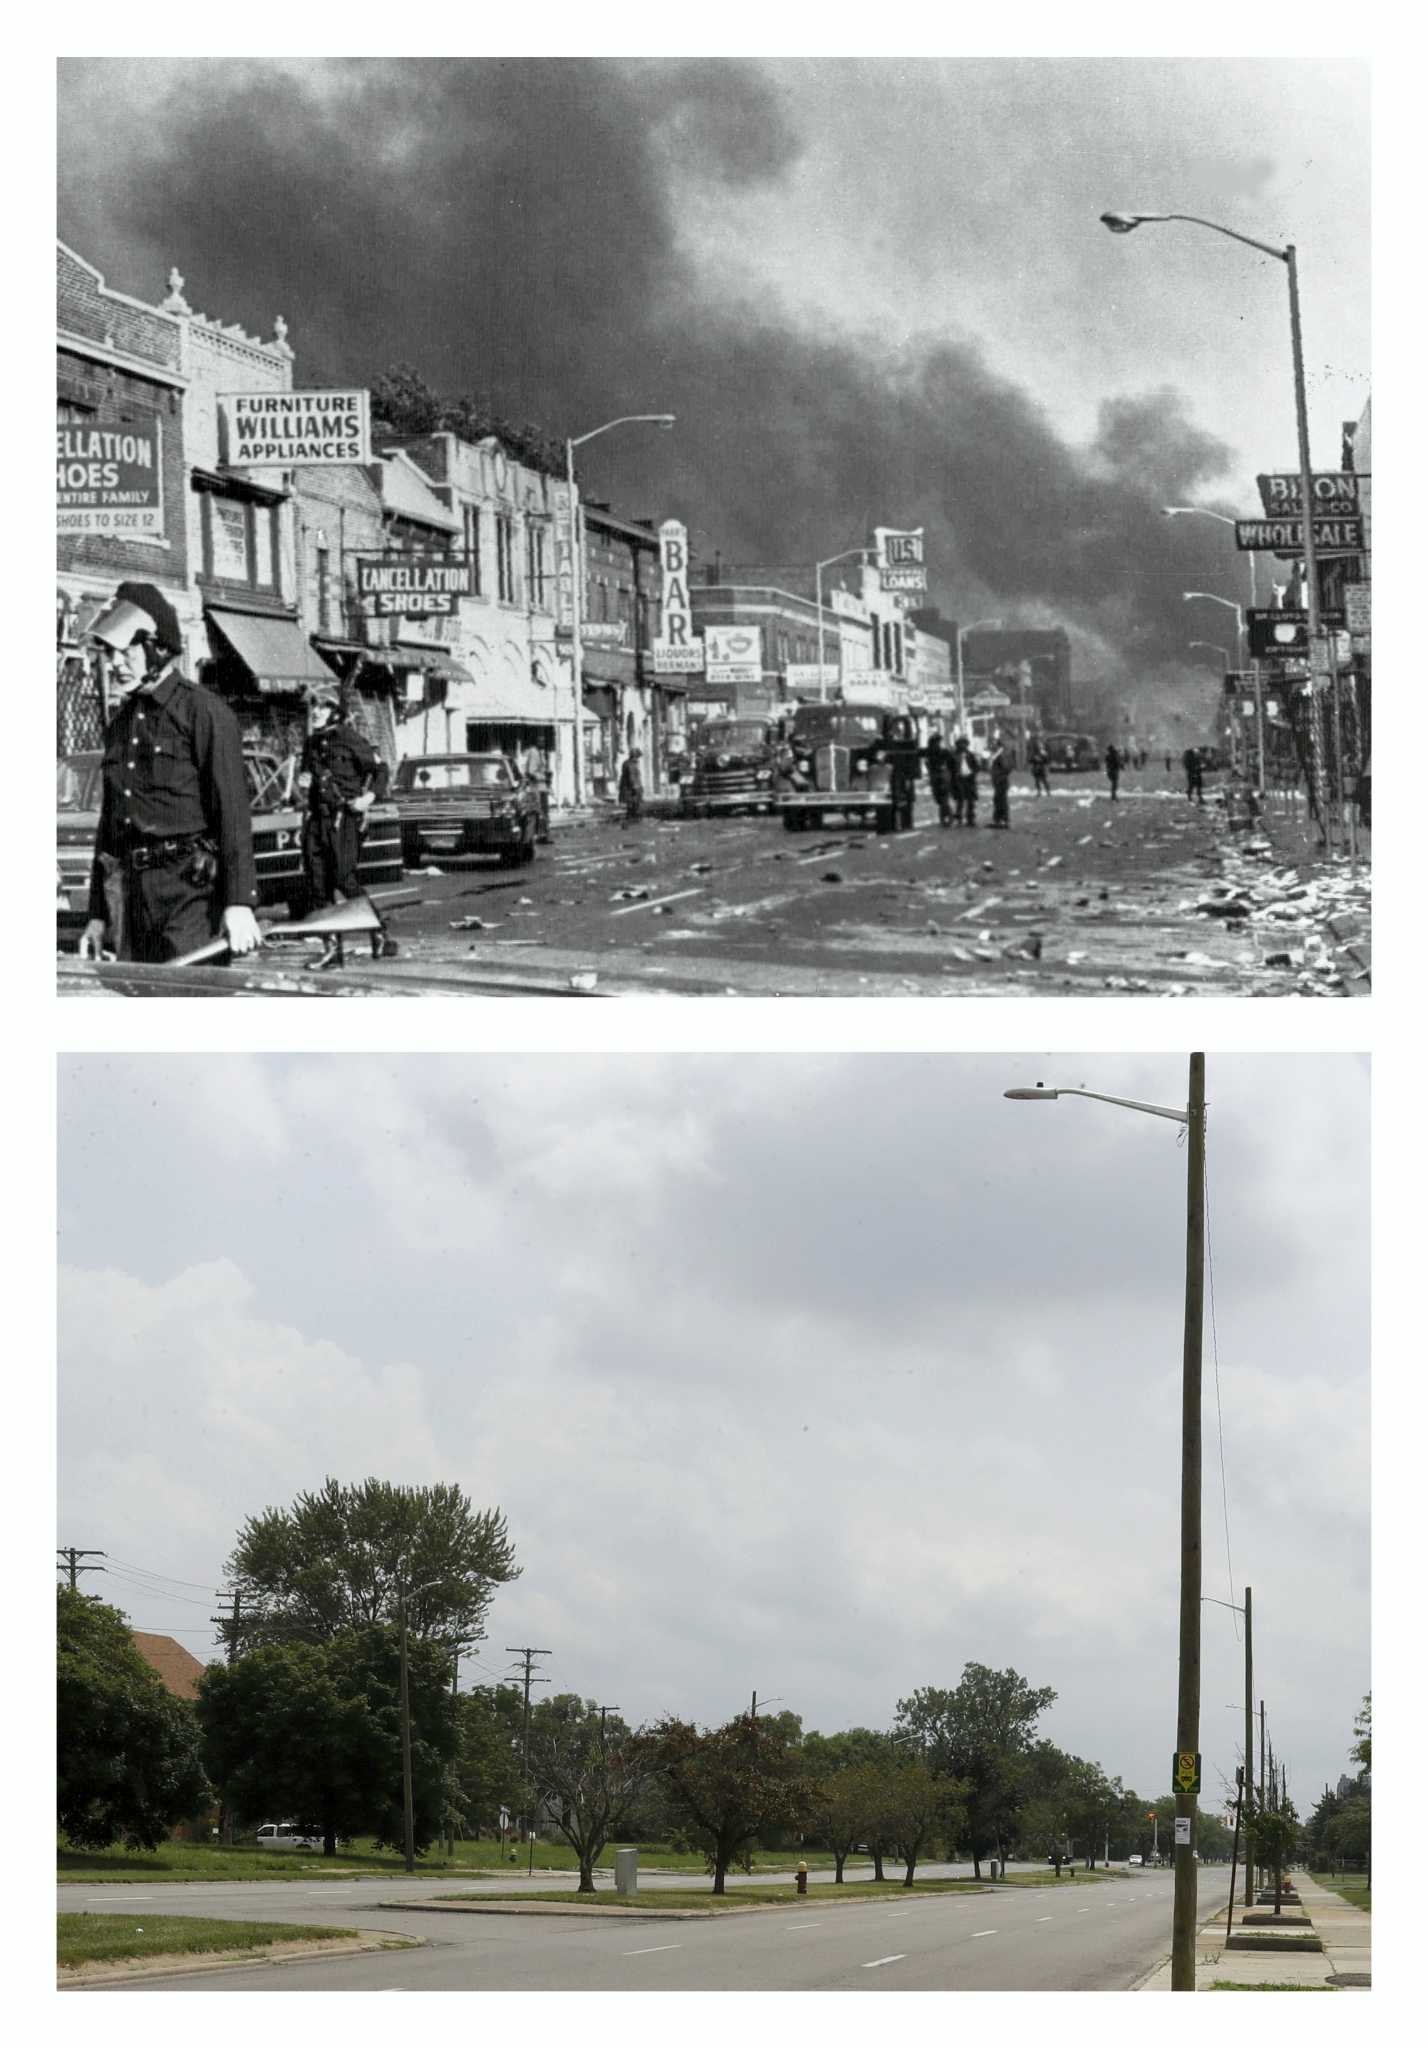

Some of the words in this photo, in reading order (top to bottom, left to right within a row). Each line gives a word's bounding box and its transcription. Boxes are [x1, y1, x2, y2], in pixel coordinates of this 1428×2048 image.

[236, 397, 358, 413] FURNITURE
[236, 415, 360, 440] WILLIAMS
[238, 442, 360, 459] APPLIANCES
[1270, 477, 1355, 499] BION
[102, 490, 149, 504] FAMILY
[1270, 501, 1323, 514] SALS
[95, 513, 110, 527] TO
[114, 513, 138, 527] SIZE
[143, 513, 154, 527] 12
[362, 567, 469, 592] CANCELLATION
[883, 576, 923, 590] LOANS
[665, 540, 688, 646] BAR
[380, 593, 452, 612] SHOES
[656, 648, 700, 659] LIQUORS
